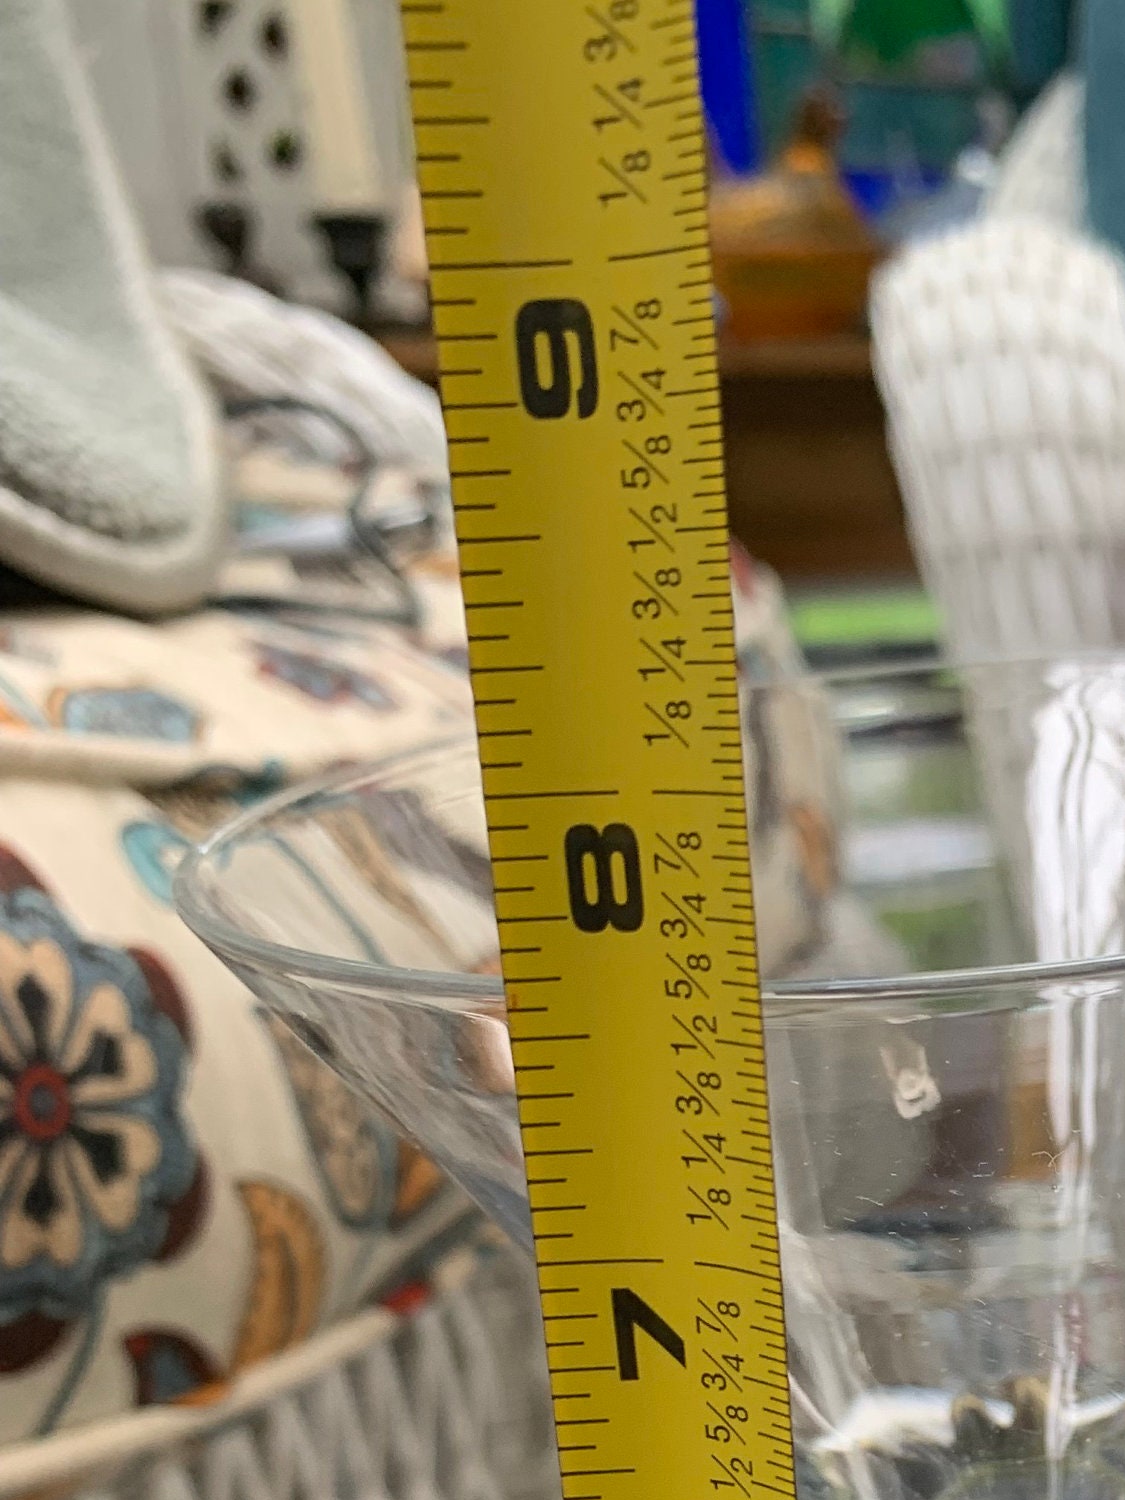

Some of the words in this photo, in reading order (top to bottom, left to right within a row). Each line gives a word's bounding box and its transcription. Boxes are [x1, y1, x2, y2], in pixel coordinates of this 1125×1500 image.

[591, 77, 644, 133] 1/4
[597, 150, 651, 206] 1/8
[609, 298, 662, 351] 7/8
[515, 298, 599, 420] 9
[616, 368, 666, 422] 3/4
[621, 434, 672, 489] 5/8
[627, 502, 677, 553] 1/2
[632, 567, 682, 620] 3/8
[638, 637, 687, 682] 1/4
[643, 700, 692, 748] 1/8
[564, 822, 644, 933] 8
[653, 831, 702, 878] 7/8
[660, 891, 706, 939] 3/4
[664, 952, 712, 999] 5/8
[671, 1013, 717, 1059] 1/2
[676, 1070, 722, 1116] 3/8
[681, 1128, 726, 1174] 1/4
[686, 1185, 731, 1231] 1/8
[611, 1287, 687, 1381] 7
[696, 1297, 740, 1343] 7/8
[701, 1348, 744, 1393] 3/4
[705, 1401, 749, 1446] 5/8
[710, 1453, 753, 1499] 1/2
